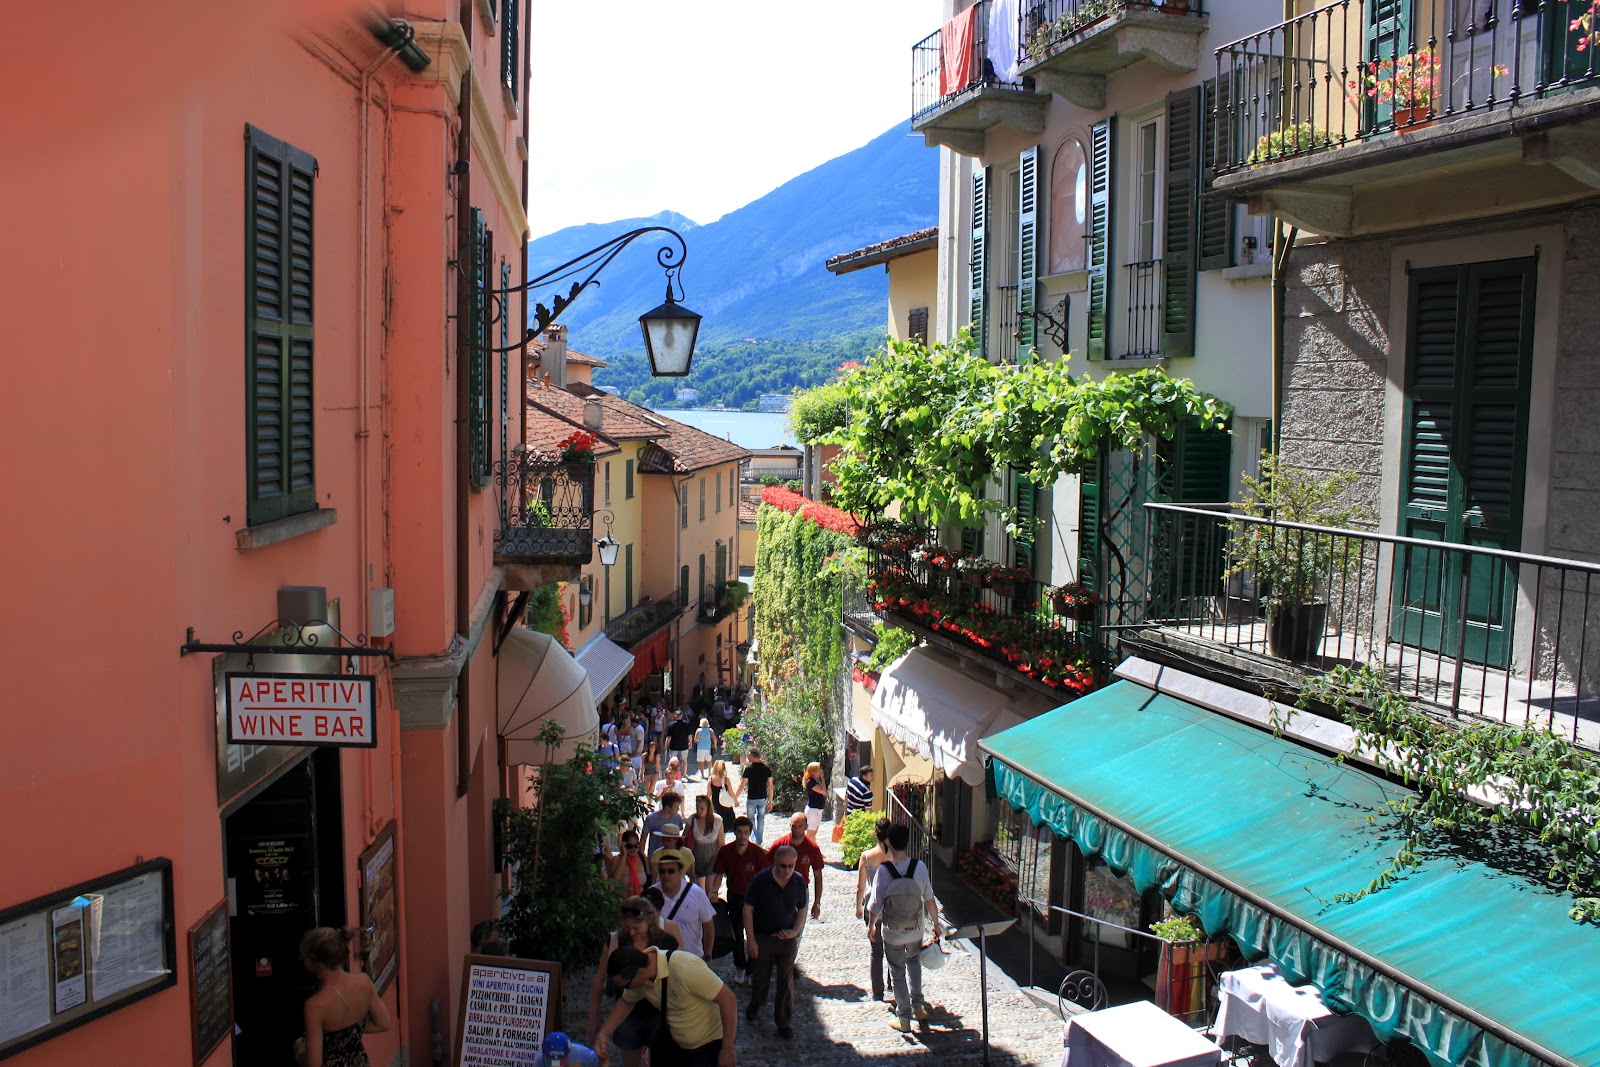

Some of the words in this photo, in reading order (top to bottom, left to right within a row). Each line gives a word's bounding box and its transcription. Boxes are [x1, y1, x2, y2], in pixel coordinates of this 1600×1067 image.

[239, 682, 362, 703] APERITIVI
[239, 715, 302, 736] WINE
[315, 716, 364, 737] BAR
[473, 968, 526, 980] aperitivo
[472, 979, 485, 988] VINI
[486, 981, 515, 991] APERITIVI
[522, 985, 544, 995] CUCINA
[1234, 898, 1491, 1067] TRATTORIA
[471, 989, 511, 1003] PIZZOCCHERI
[516, 995, 543, 1006] LASAGNA
[468, 1012, 483, 1023] BIRRA
[483, 1014, 502, 1025] LOCALE
[499, 1004, 518, 1015] PASTA
[520, 1007, 542, 1018] FRESCA
[467, 1025, 494, 1037] SALUMI
[495, 1028, 500, 1038] &
[502, 1029, 539, 1042] FORMAGGI
[465, 1036, 502, 1047] SELEZIONATI
[503, 1041, 540, 1051] ALL'ORIGINE
[464, 1055, 482, 1064] AMPIA
[483, 1057, 516, 1067] SELEZIONE
[467, 1046, 504, 1057] INSALATONE
[511, 1051, 536, 1061] PIADINE
